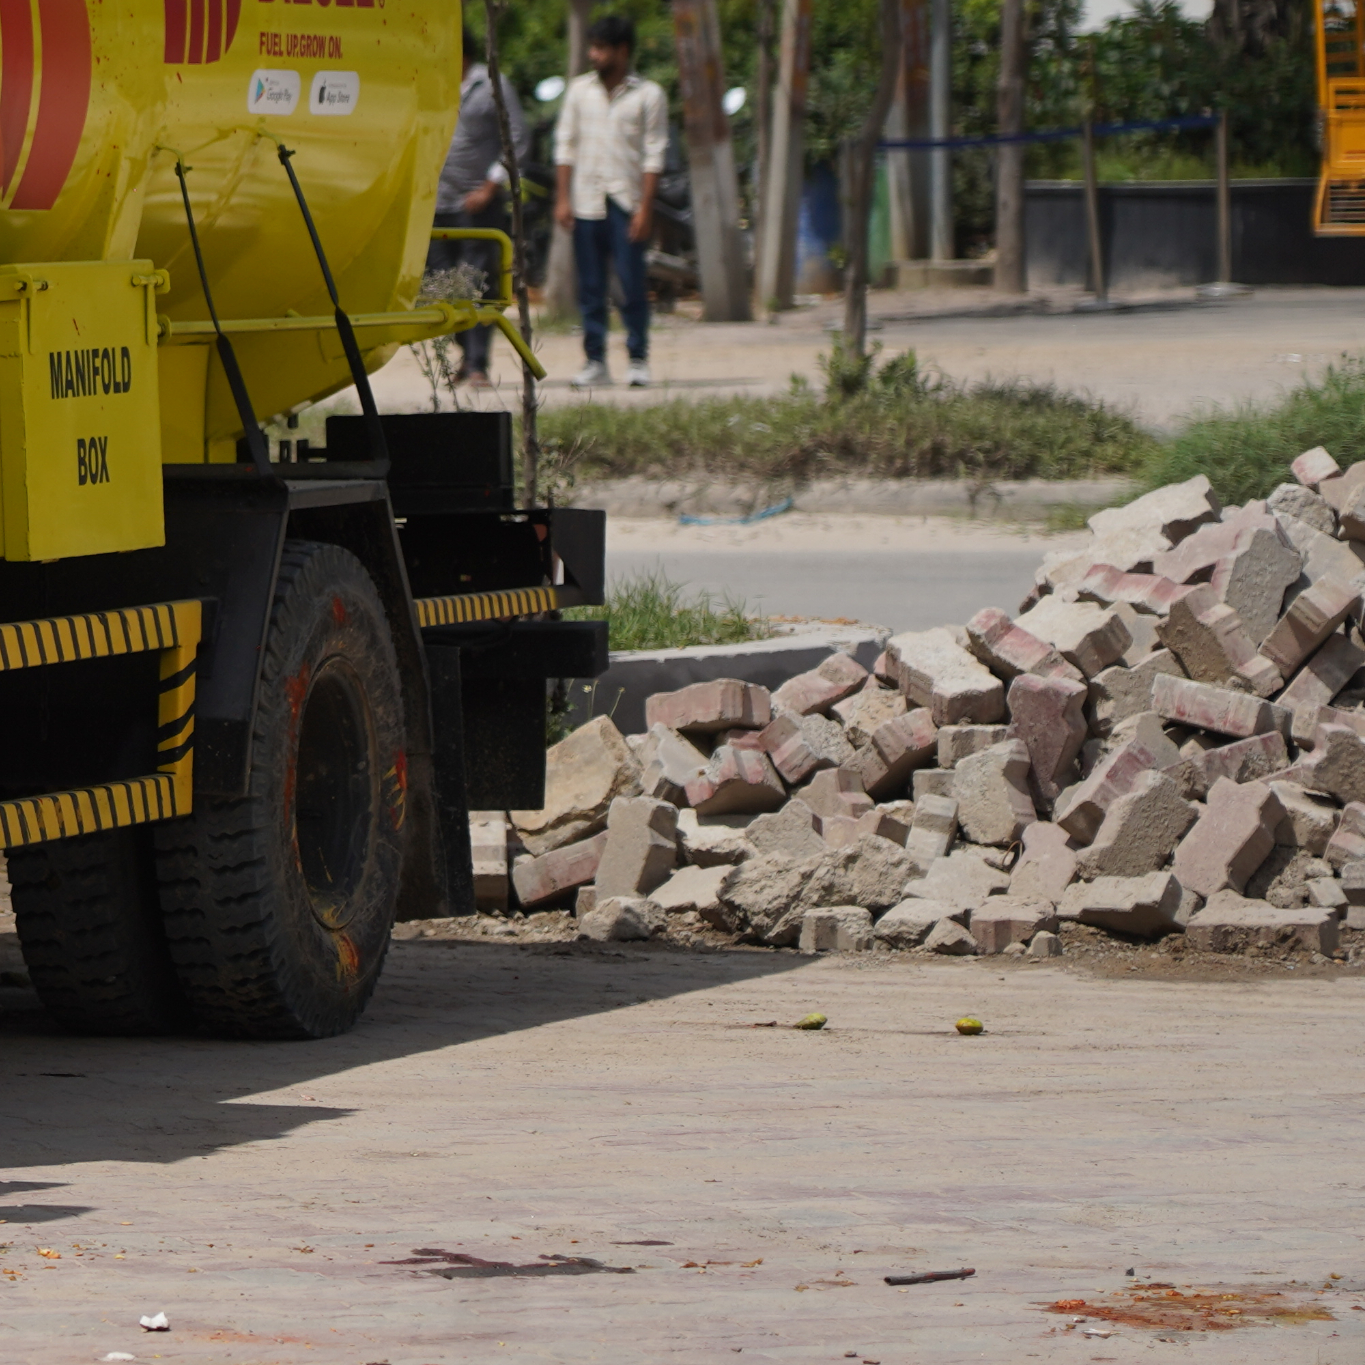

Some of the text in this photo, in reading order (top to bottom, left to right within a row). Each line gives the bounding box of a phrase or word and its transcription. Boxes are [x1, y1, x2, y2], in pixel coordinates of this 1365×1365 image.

[259, 31, 283, 57] FUEL
[49, 346, 131, 399] MANIFOLD
[77, 436, 110, 486] BOX
